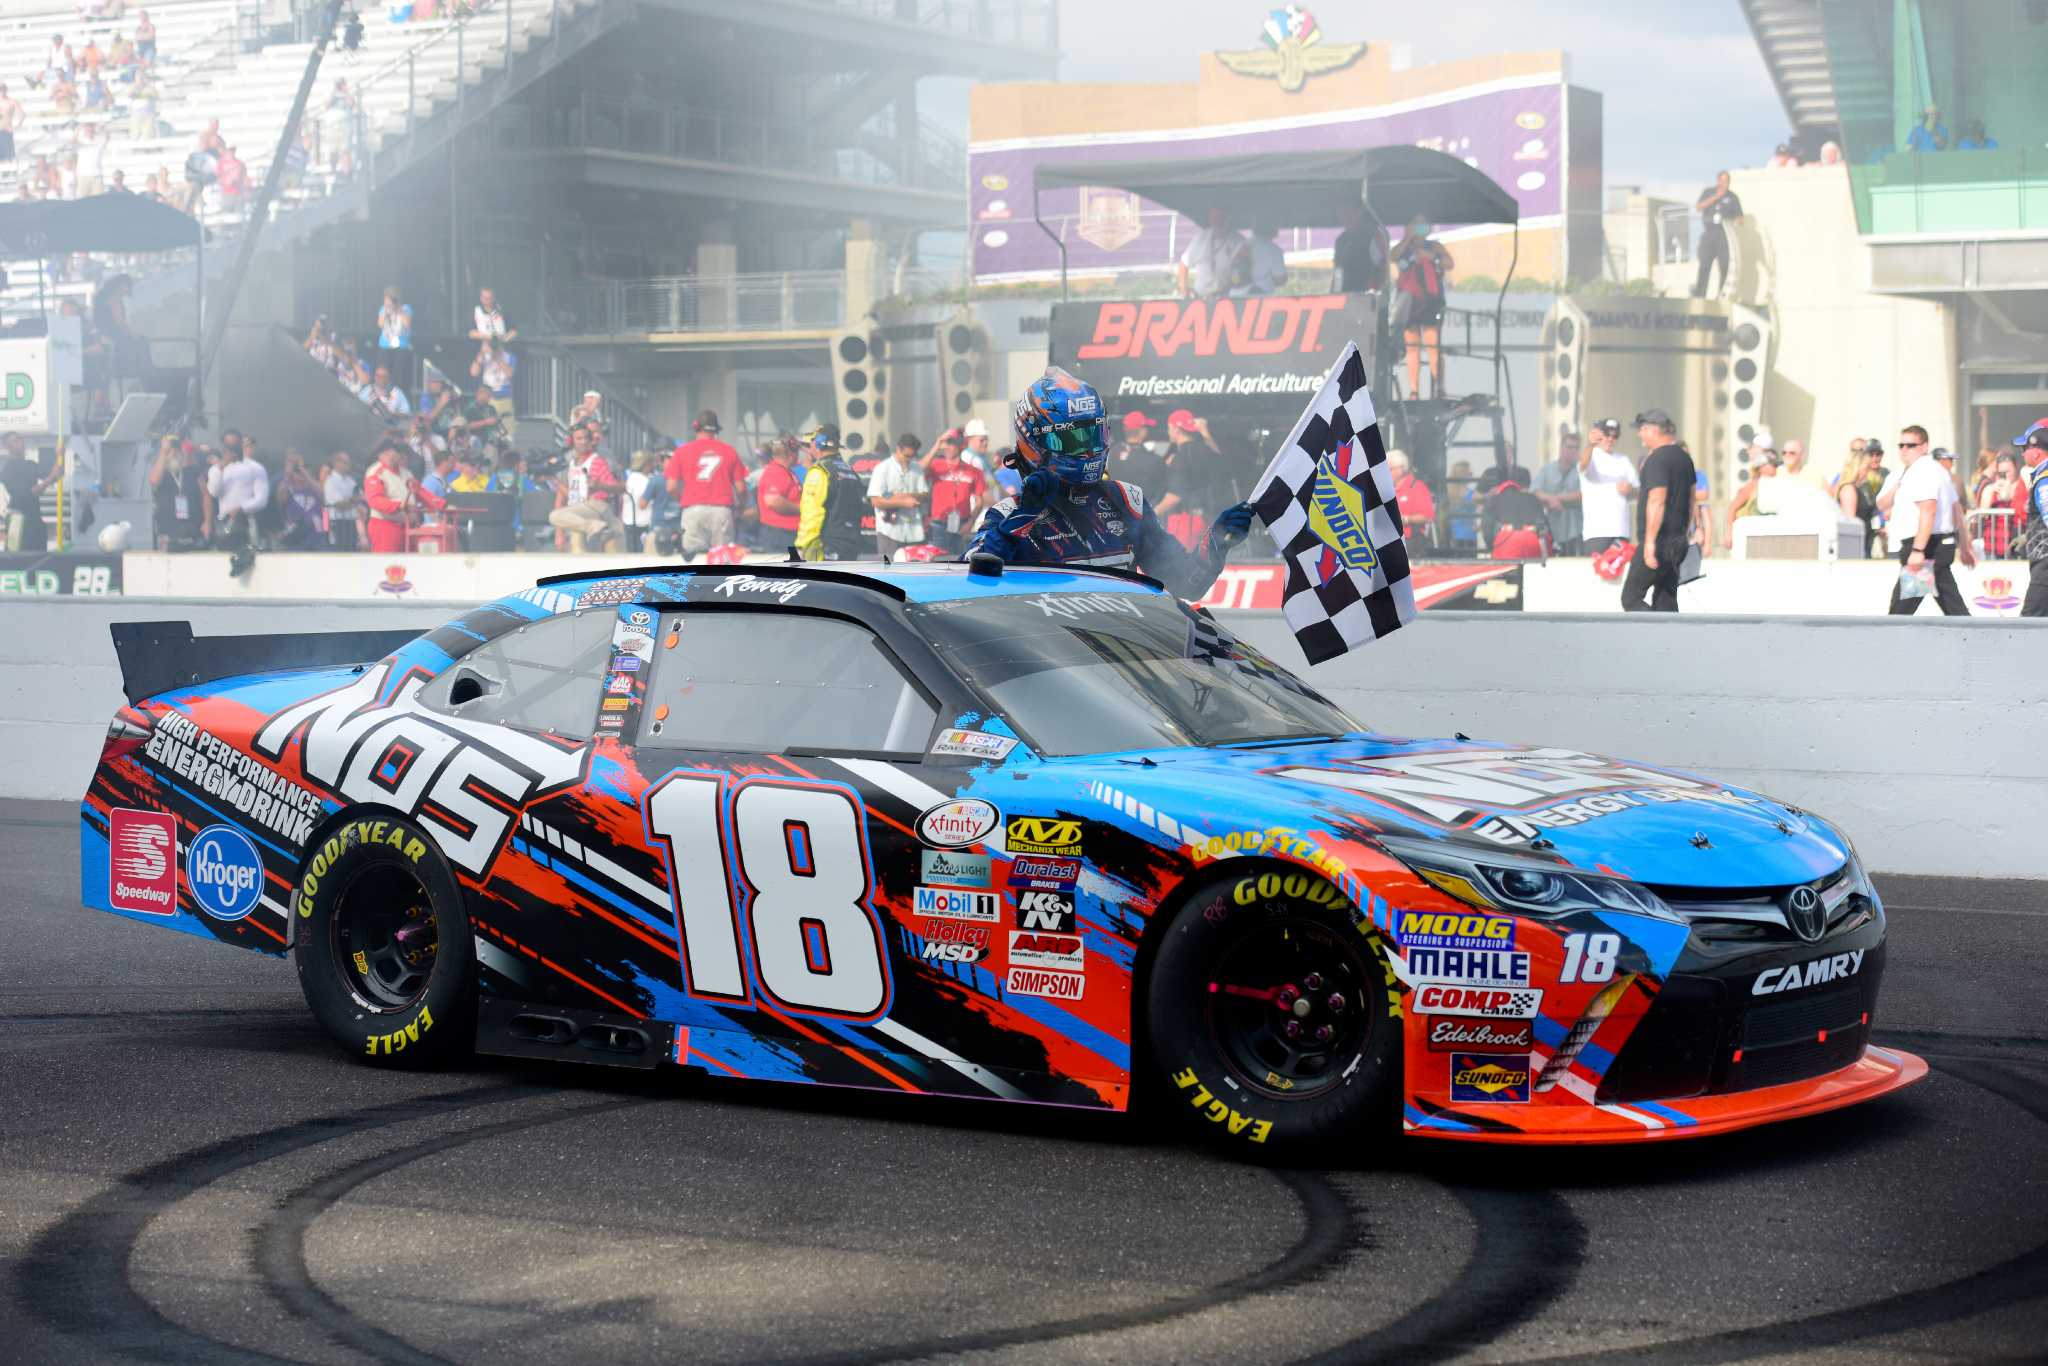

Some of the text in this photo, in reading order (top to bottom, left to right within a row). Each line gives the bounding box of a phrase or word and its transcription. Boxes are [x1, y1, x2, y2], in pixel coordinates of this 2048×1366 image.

[1077, 296, 1347, 360] BRANDT
[1117, 371, 1325, 397] Professional Agriculture
[697, 455, 722, 481] 7
[73, 566, 111, 597] 28
[623, 624, 651, 634] TOYOTA
[936, 744, 999, 756] RACE CAR
[156, 710, 323, 818] HIGH PERFORMANCE
[258, 663, 588, 877] NOS
[146, 728, 315, 847] ENERGY DRINK
[929, 815, 982, 837] xfinity
[1472, 789, 1648, 846] ENERGY
[944, 833, 965, 841] SERIES
[1008, 840, 1082, 856] MECHANIX WEAR
[1191, 827, 1348, 877] GOODYEAR
[196, 840, 257, 907] Kroger
[298, 821, 427, 919] GOODYEAR
[960, 865, 987, 877] LIGHT
[1015, 858, 1075, 879] Duralast
[115, 882, 170, 906] Speedway
[646, 774, 888, 1018] 18
[1030, 880, 1060, 889] BRAKES
[918, 889, 971, 913] Mobil
[1019, 892, 1073, 914] K&
[1023, 910, 1063, 930] N
[1400, 912, 1513, 939] MOOG
[924, 919, 990, 950] Holley
[1012, 933, 1081, 955] ARP
[1402, 934, 1507, 949] STEERING & SUSPENSION
[922, 942, 980, 963] MSD
[1409, 948, 1528, 981] MAHLE
[1559, 932, 1622, 984] 18
[1010, 970, 1081, 997] SIMPSON
[1751, 948, 1865, 996] CAMRY
[1420, 987, 1512, 1010] COMP
[1481, 1006, 1525, 1016] CAMS
[365, 1005, 434, 1056] EAGLE
[1456, 1070, 1524, 1085] SUNOCO
[1171, 1066, 1274, 1144] EAGLE
